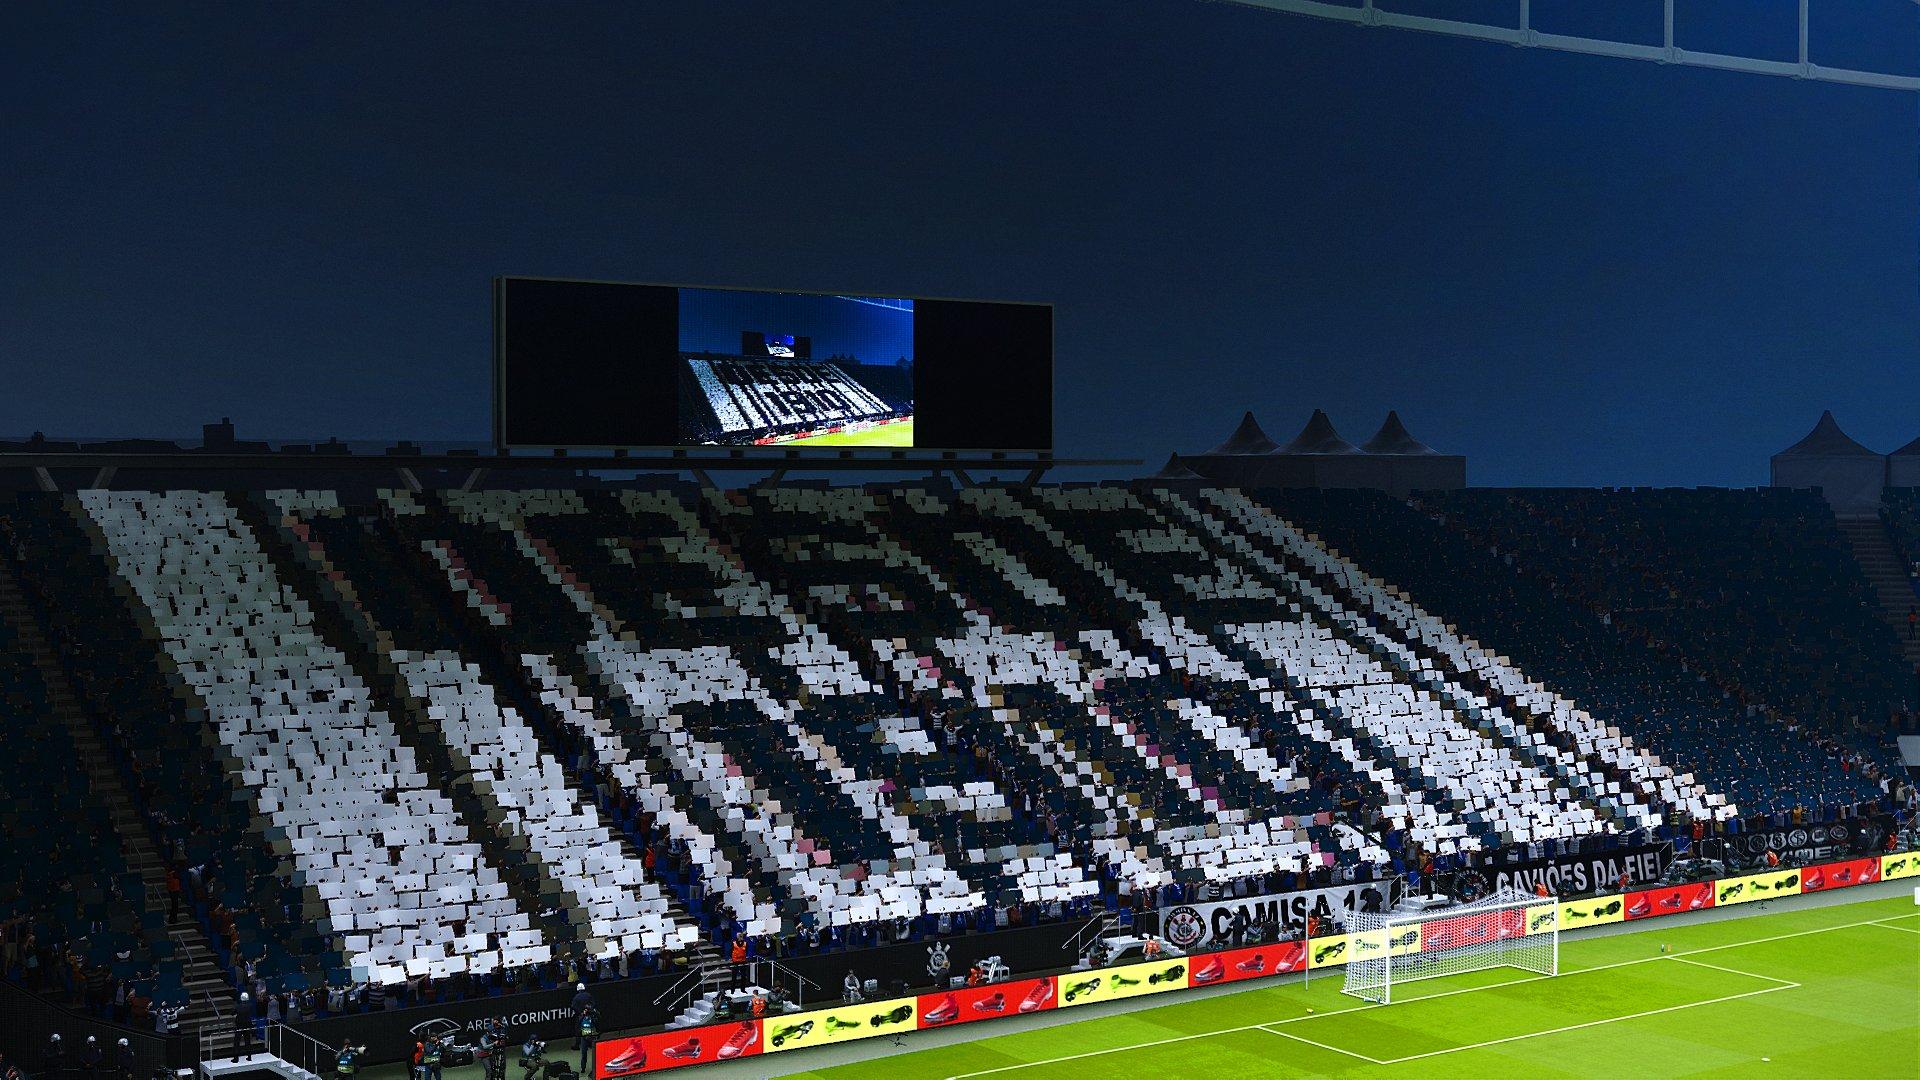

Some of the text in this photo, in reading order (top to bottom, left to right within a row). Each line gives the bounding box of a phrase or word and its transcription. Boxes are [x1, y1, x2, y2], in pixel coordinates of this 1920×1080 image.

[1592, 858, 1619, 889] DA
[1211, 894, 1332, 940] CAMISA
[467, 1016, 509, 1032] AREA
